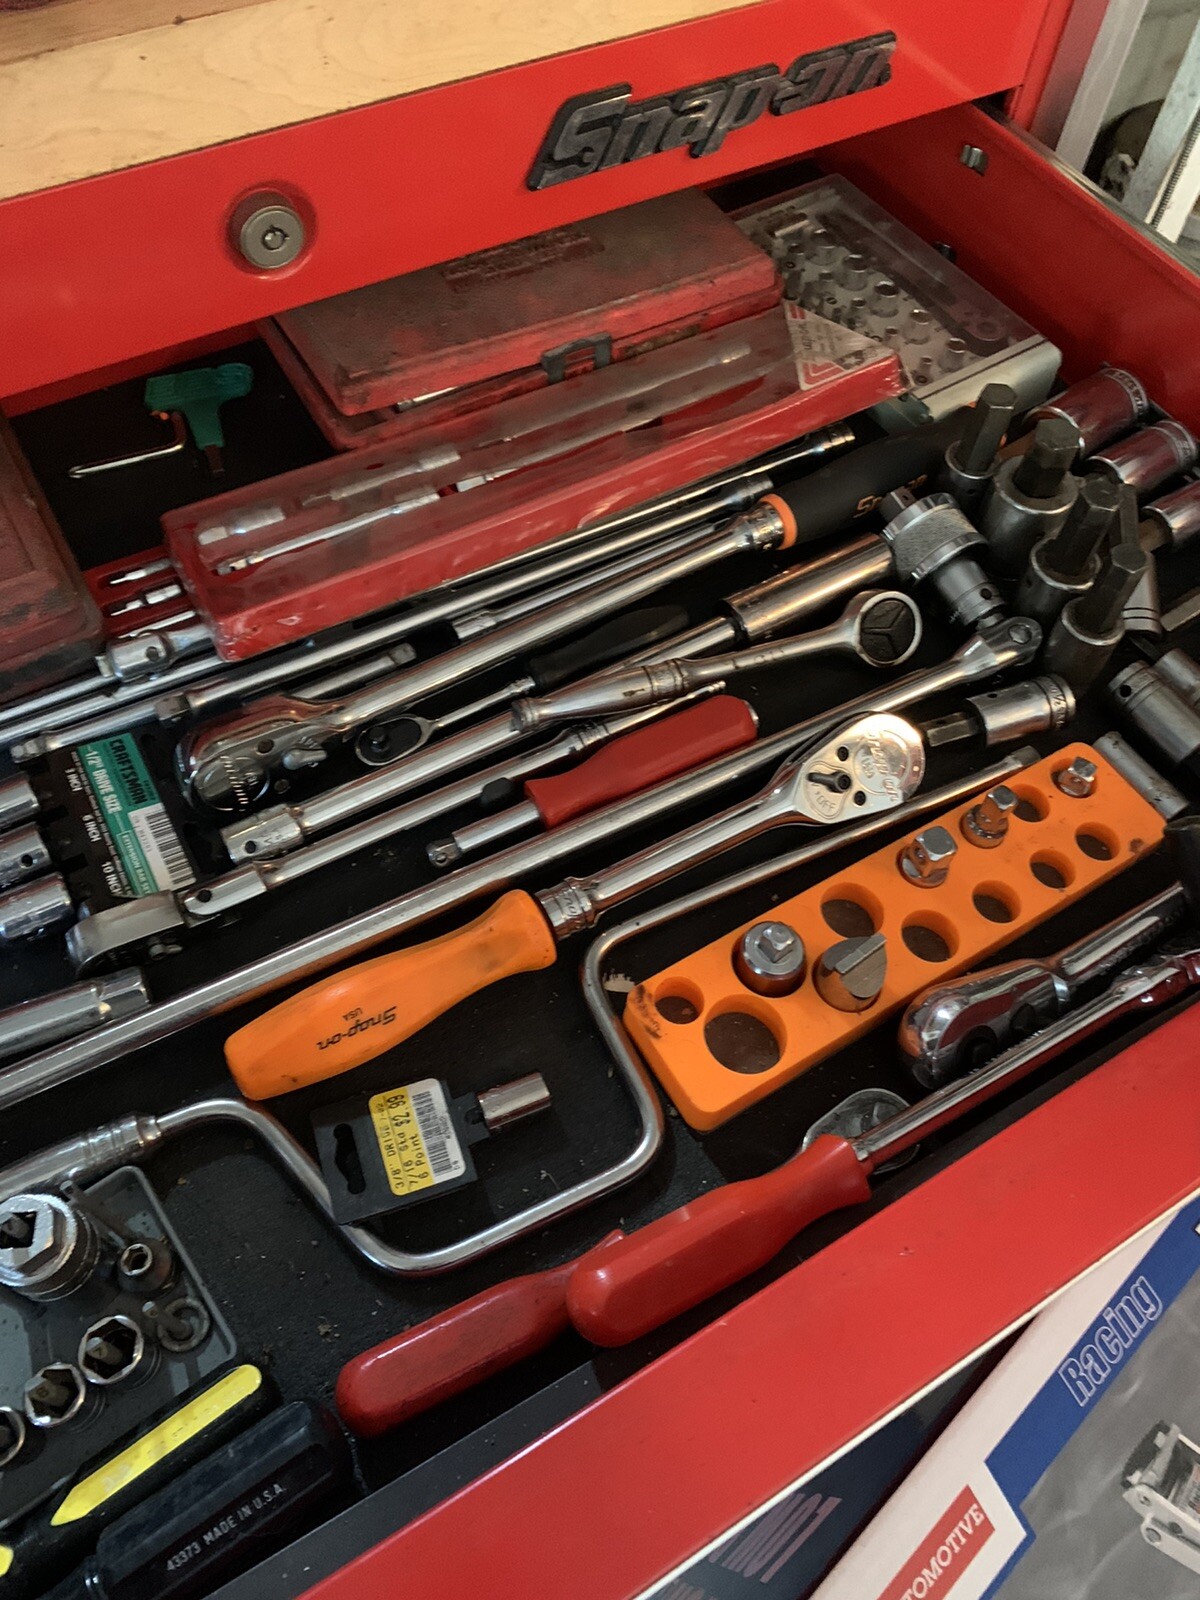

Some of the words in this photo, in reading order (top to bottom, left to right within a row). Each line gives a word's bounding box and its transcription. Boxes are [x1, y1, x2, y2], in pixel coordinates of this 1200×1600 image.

[526, 30, 897, 191] Snap-on
[92, 767, 115, 796] DRIVE
[109, 738, 149, 805] CRAFTSMAN
[82, 813, 95, 822] 6
[102, 793, 122, 815] SIZE
[85, 820, 102, 843] INCH
[101, 860, 115, 874] 10
[121, 833, 143, 869] EXTENSION
[316, 1006, 397, 1051] Snap-on
[342, 1007, 363, 1021] USA
[387, 1094, 412, 1128] $2.99
[409, 1133, 426, 1168] Point
[417, 1170, 430, 1180] 6
[1058, 1275, 1163, 1407] Racing
[166, 1541, 202, 1572] 43373
[203, 1515, 238, 1545] MADE
[236, 1504, 252, 1522] IN
[252, 1483, 287, 1510] U.S.A.
